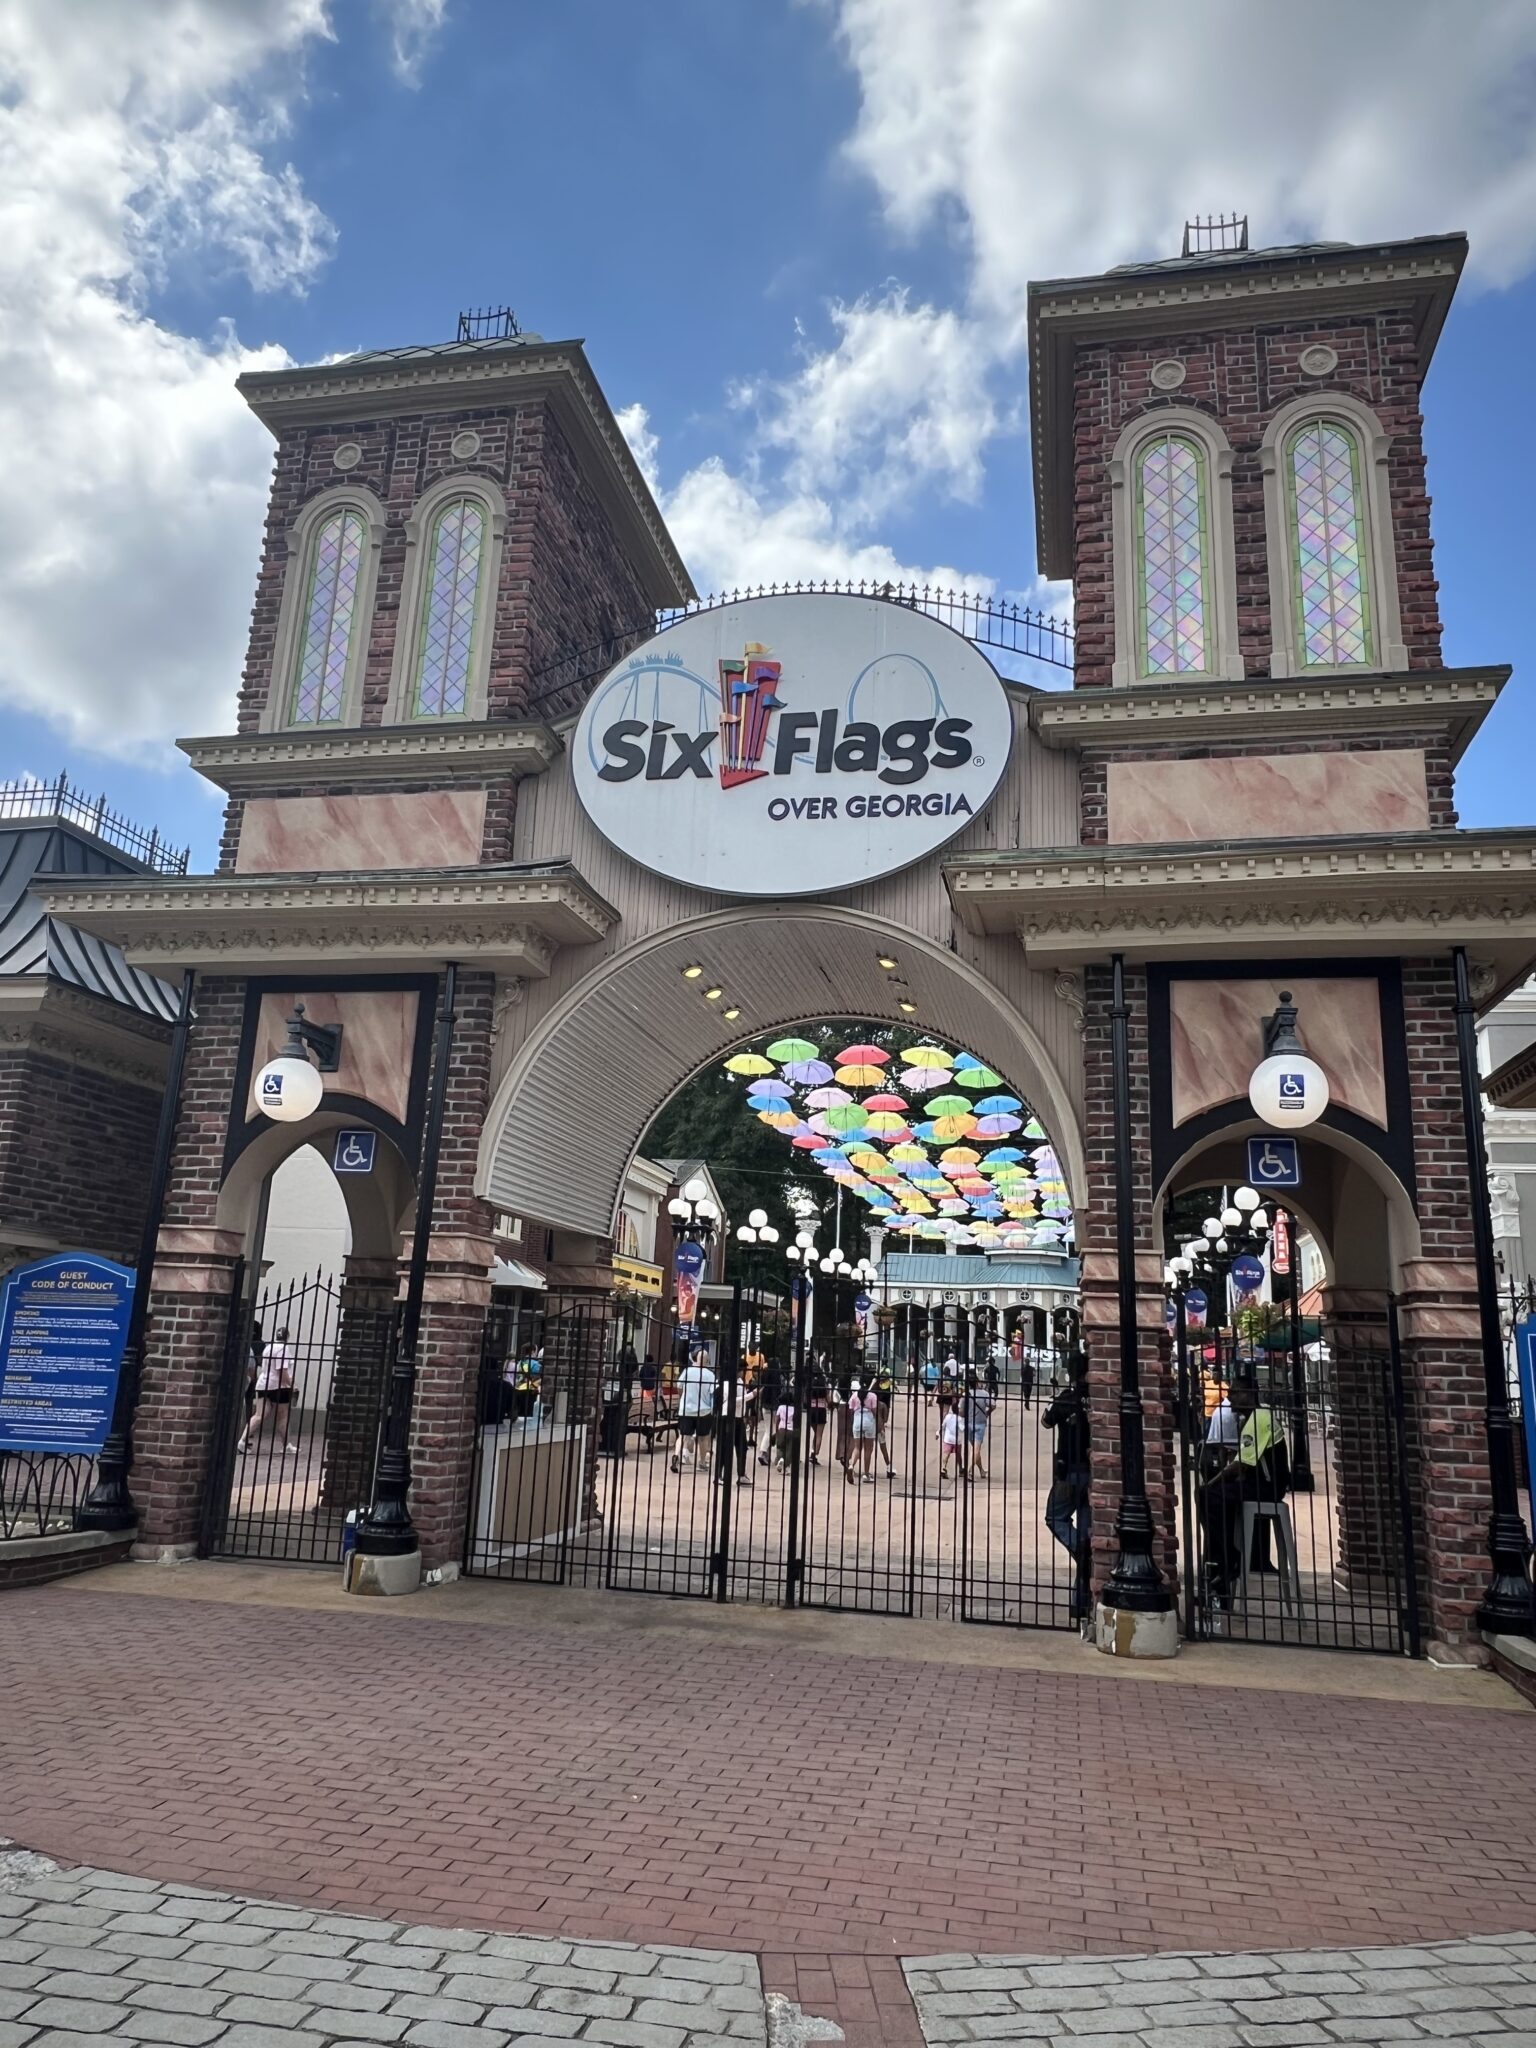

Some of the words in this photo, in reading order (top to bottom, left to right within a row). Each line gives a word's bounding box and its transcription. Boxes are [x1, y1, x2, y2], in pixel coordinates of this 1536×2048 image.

[597, 719, 718, 782] Six
[773, 708, 973, 785] Flags
[768, 796, 838, 821] OVER
[846, 792, 974, 818] GEORGIA
[31, 1280, 55, 1288] CODE
[57, 1281, 70, 1289] OF
[71, 1281, 114, 1290] CONDUCT
[60, 1271, 88, 1280] GUEST
